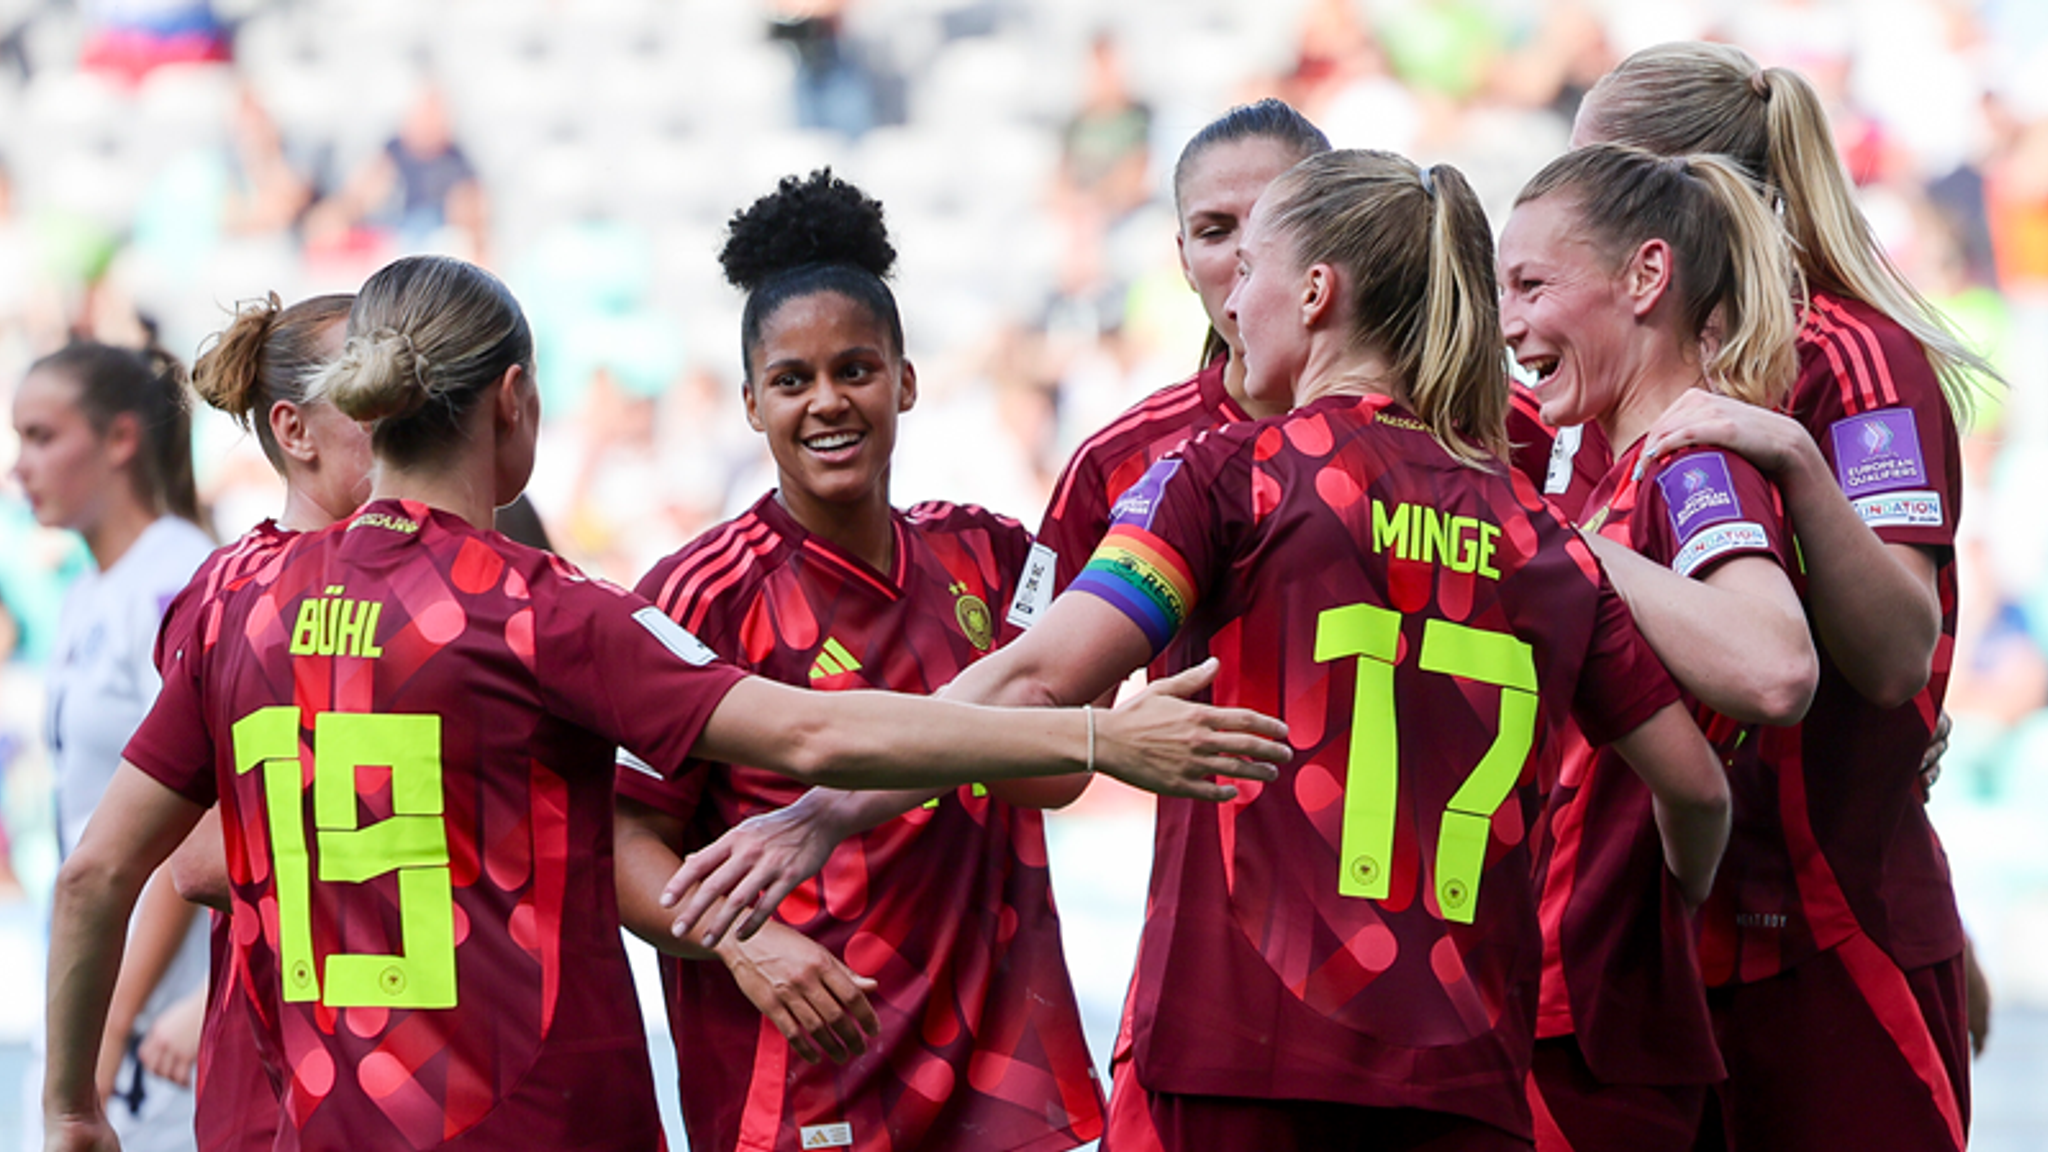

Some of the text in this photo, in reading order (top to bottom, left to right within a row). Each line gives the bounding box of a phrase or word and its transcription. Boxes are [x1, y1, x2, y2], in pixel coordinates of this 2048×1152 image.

[289, 585, 383, 658] BÜHL
[1372, 498, 1501, 580] MINGE
[231, 706, 458, 1010] 19
[1313, 602, 1539, 925] 17
